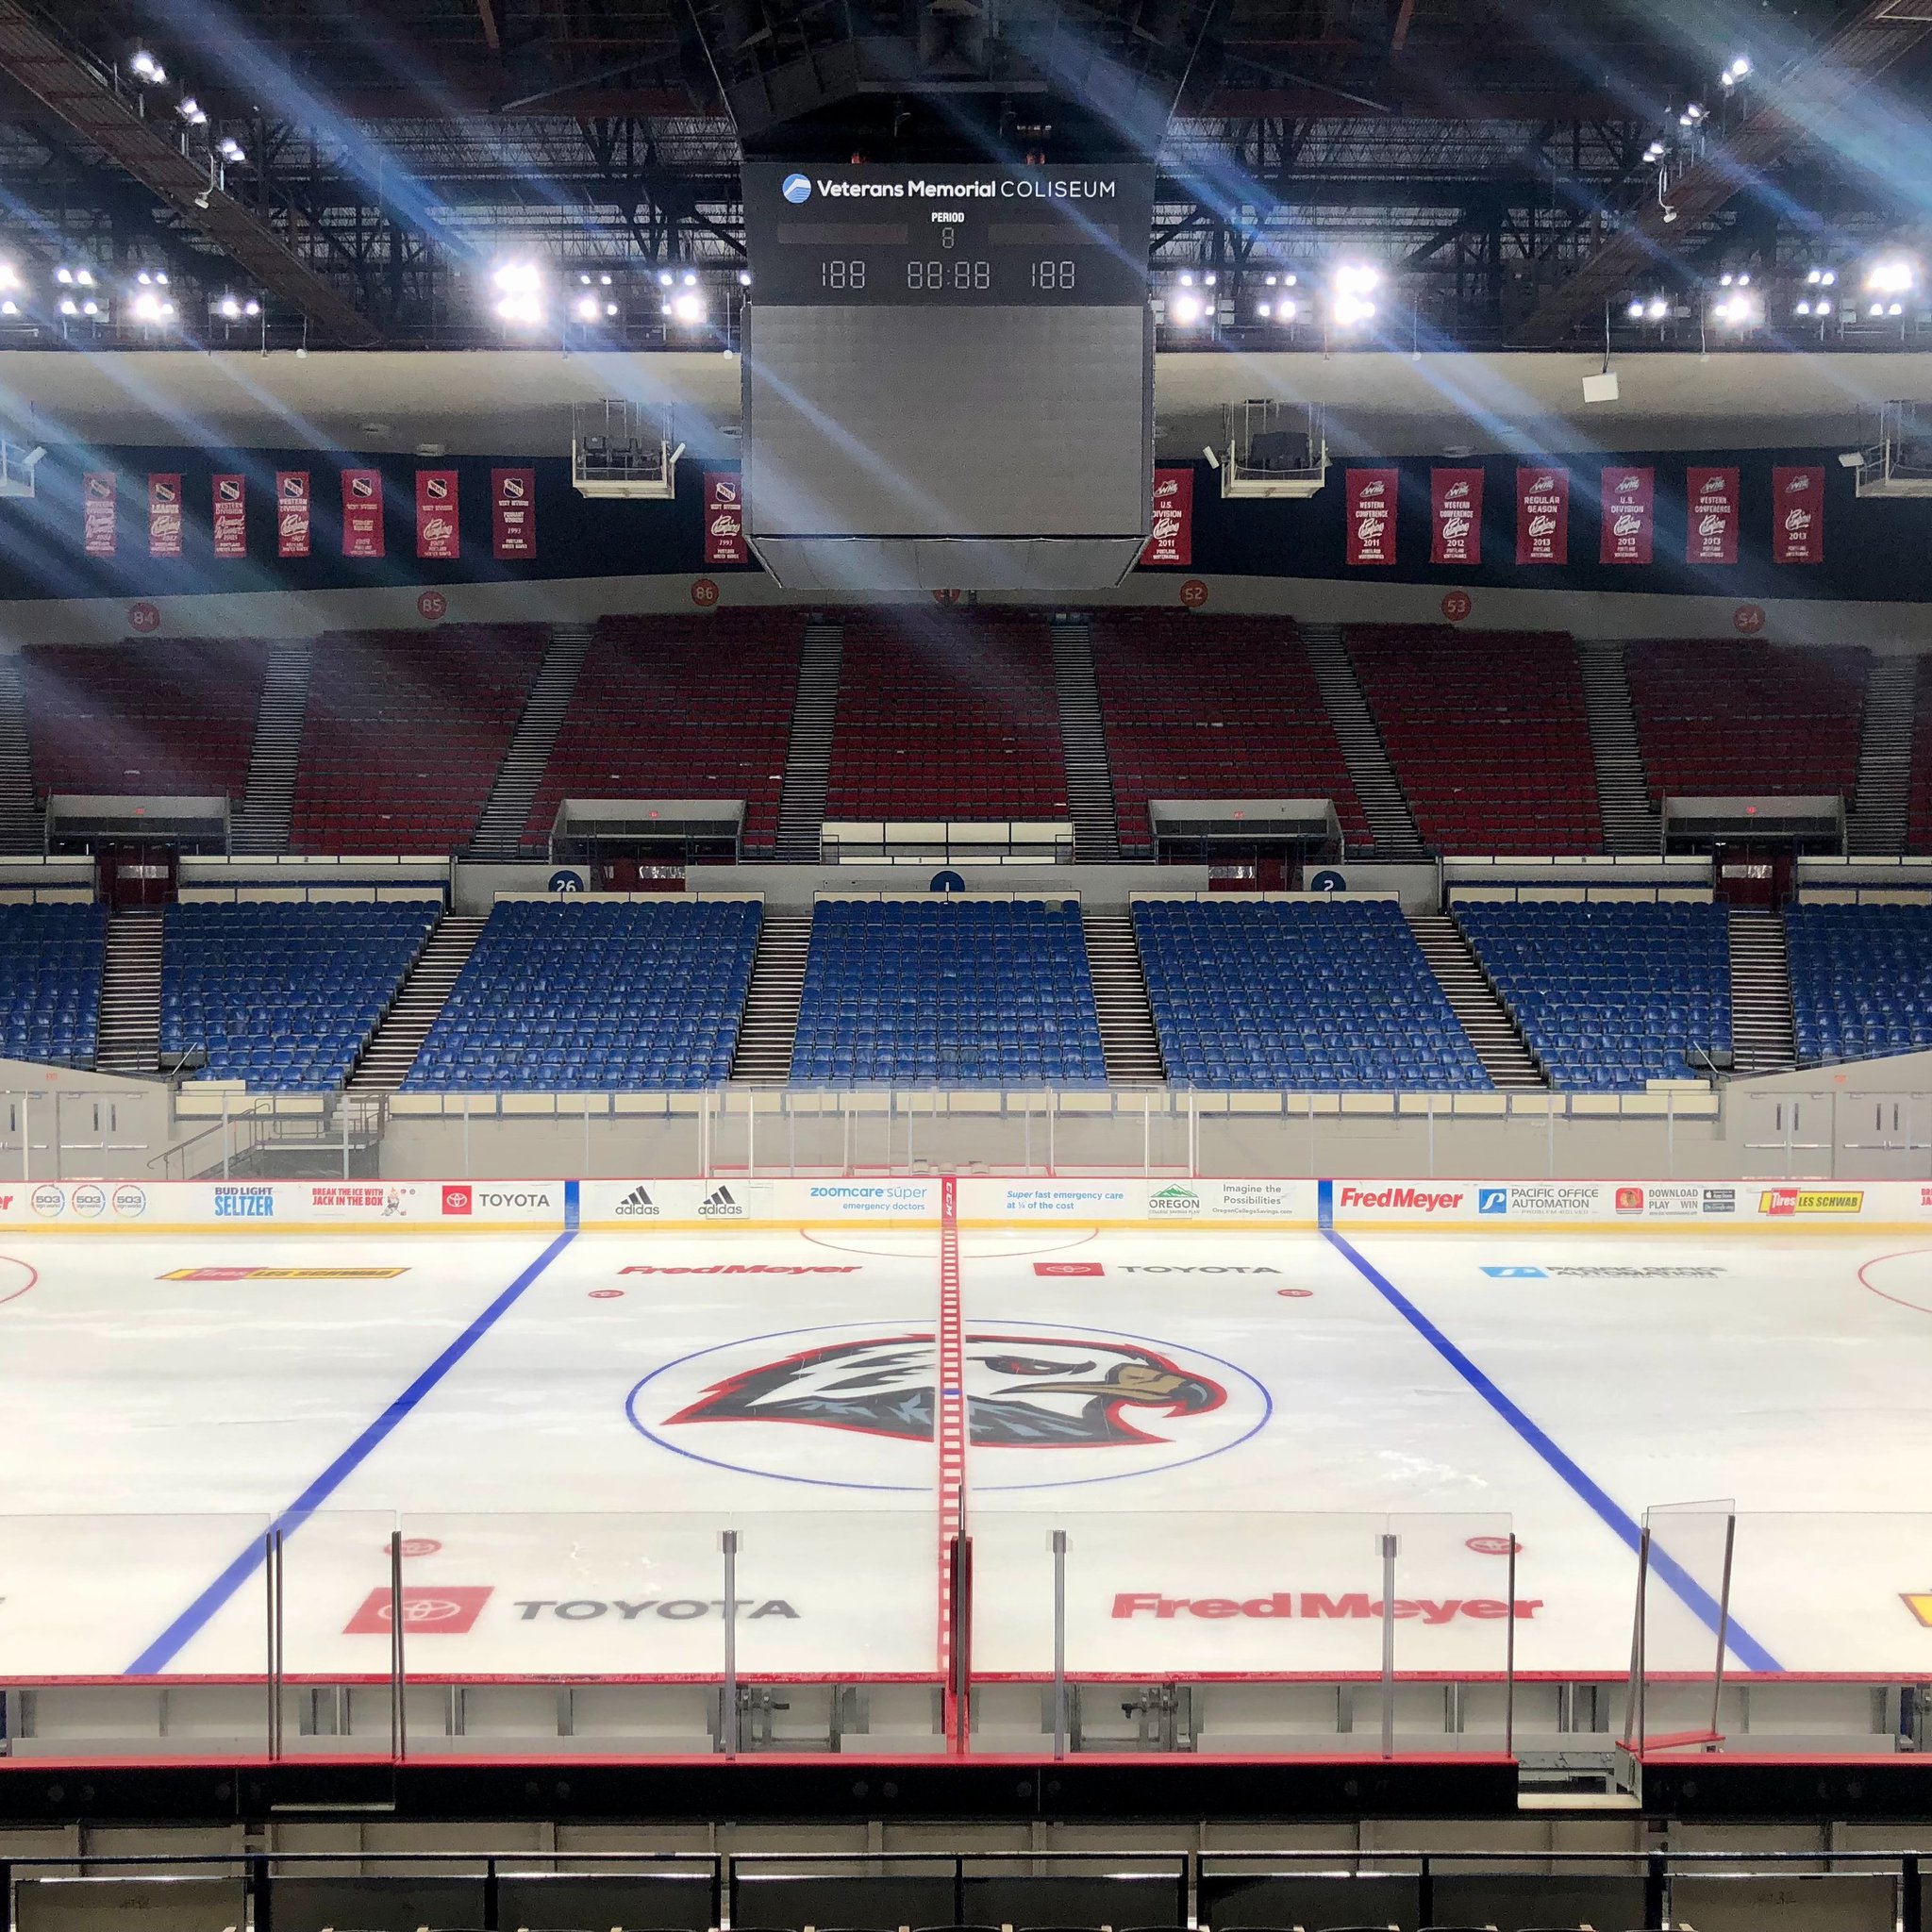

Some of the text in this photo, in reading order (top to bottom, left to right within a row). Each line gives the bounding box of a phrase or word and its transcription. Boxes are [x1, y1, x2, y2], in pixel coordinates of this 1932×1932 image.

[817, 180, 1115, 198] Veterans Memorial COLISEUM
[931, 212, 964, 224] PERIOD
[1185, 587, 1203, 600] 52
[1448, 598, 1466, 612] 53
[557, 880, 576, 891] 26
[215, 1187, 274, 1195] BUD LIGHT
[810, 1187, 884, 1197] zoomcare
[1223, 1184, 1262, 1194] Imagine
[1511, 1189, 1599, 1197] PACIFIC OFFICE
[312, 1196, 383, 1206] JACK IN THE BOX
[479, 1193, 550, 1207] TOYOTA
[1007, 1191, 1033, 1199] Super
[1035, 1191, 1051, 1199] fast
[1054, 1191, 1102, 1200] emergency
[1224, 1195, 1281, 1205] Possibilities
[1772, 1192, 1795, 1208] Tires
[215, 1195, 274, 1216] SELTZER
[842, 1203, 890, 1211] emergency
[1149, 1199, 1200, 1208] OREGON
[1512, 1199, 1590, 1208] AUTOMATION
[1798, 1197, 1857, 1208] LES SCHWAB
[615, 1204, 660, 1215] adidas
[698, 1204, 742, 1215] adidas
[513, 1600, 802, 1620] TOYOTA
[1111, 1592, 1543, 1624] Fred Meyer
